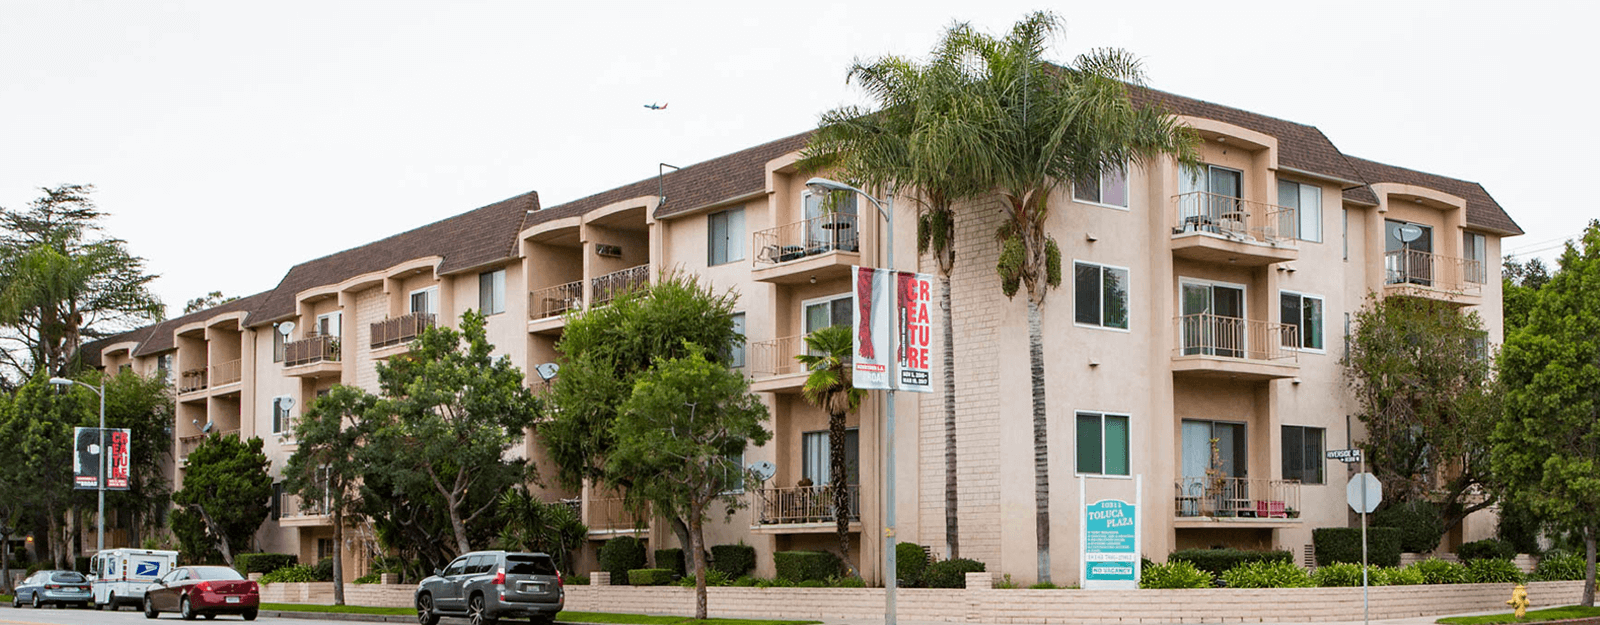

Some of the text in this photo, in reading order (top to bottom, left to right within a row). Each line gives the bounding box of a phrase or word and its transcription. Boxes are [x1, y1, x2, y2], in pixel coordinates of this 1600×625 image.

[1326, 450, 1351, 458] RIVERSIDE
[1089, 509, 1124, 520] TOLUCA
[1106, 517, 1133, 528] PLAZA
